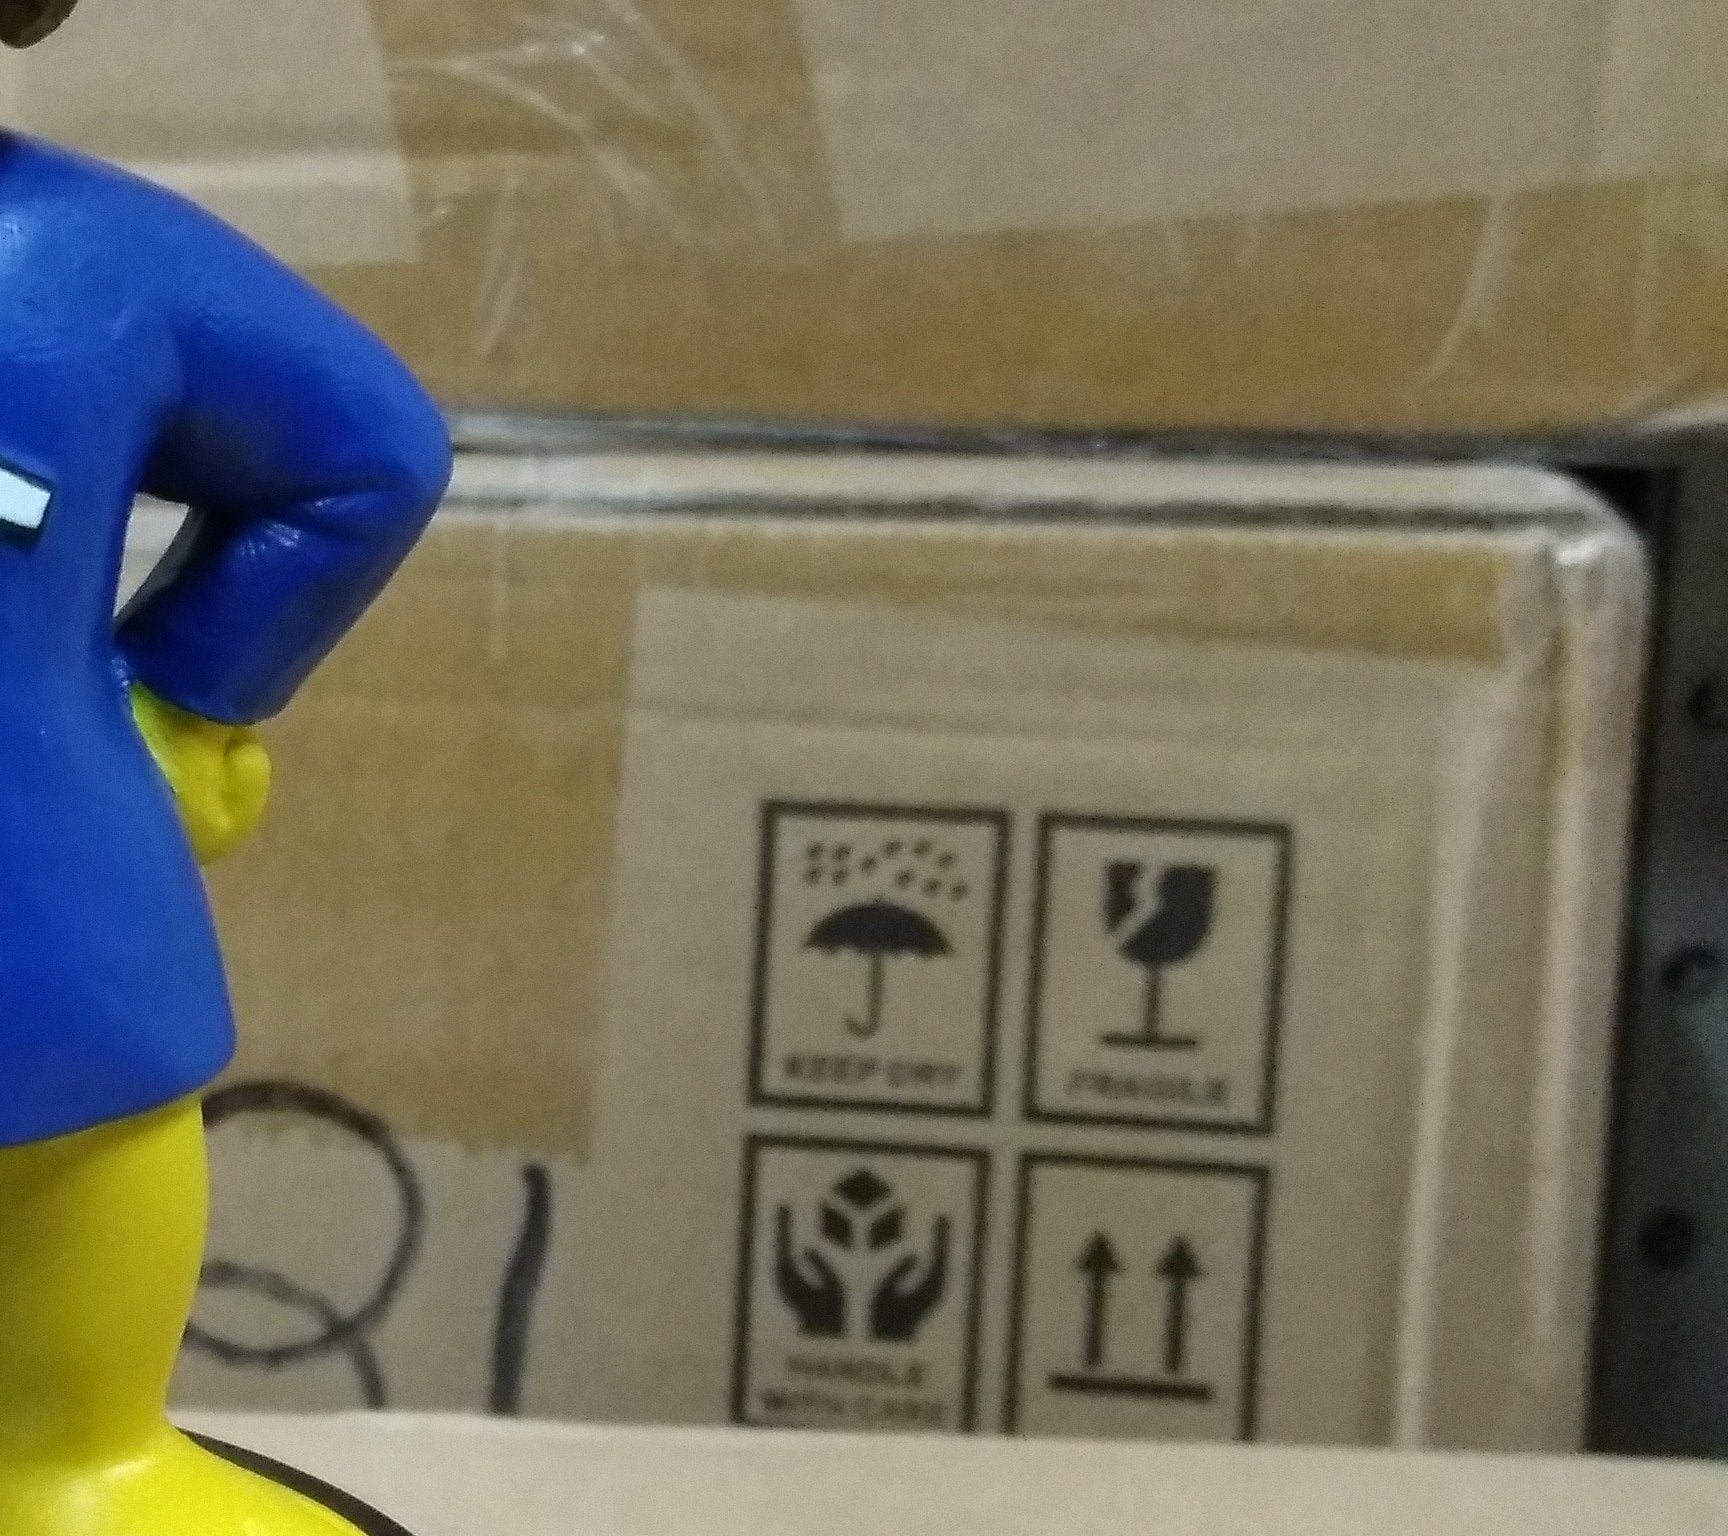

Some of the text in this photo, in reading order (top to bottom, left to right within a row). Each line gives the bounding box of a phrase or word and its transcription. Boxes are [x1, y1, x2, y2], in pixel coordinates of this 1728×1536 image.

[782, 1050, 963, 1089] KEEP DRY
[1065, 1068, 1231, 1109] FRAGILE
